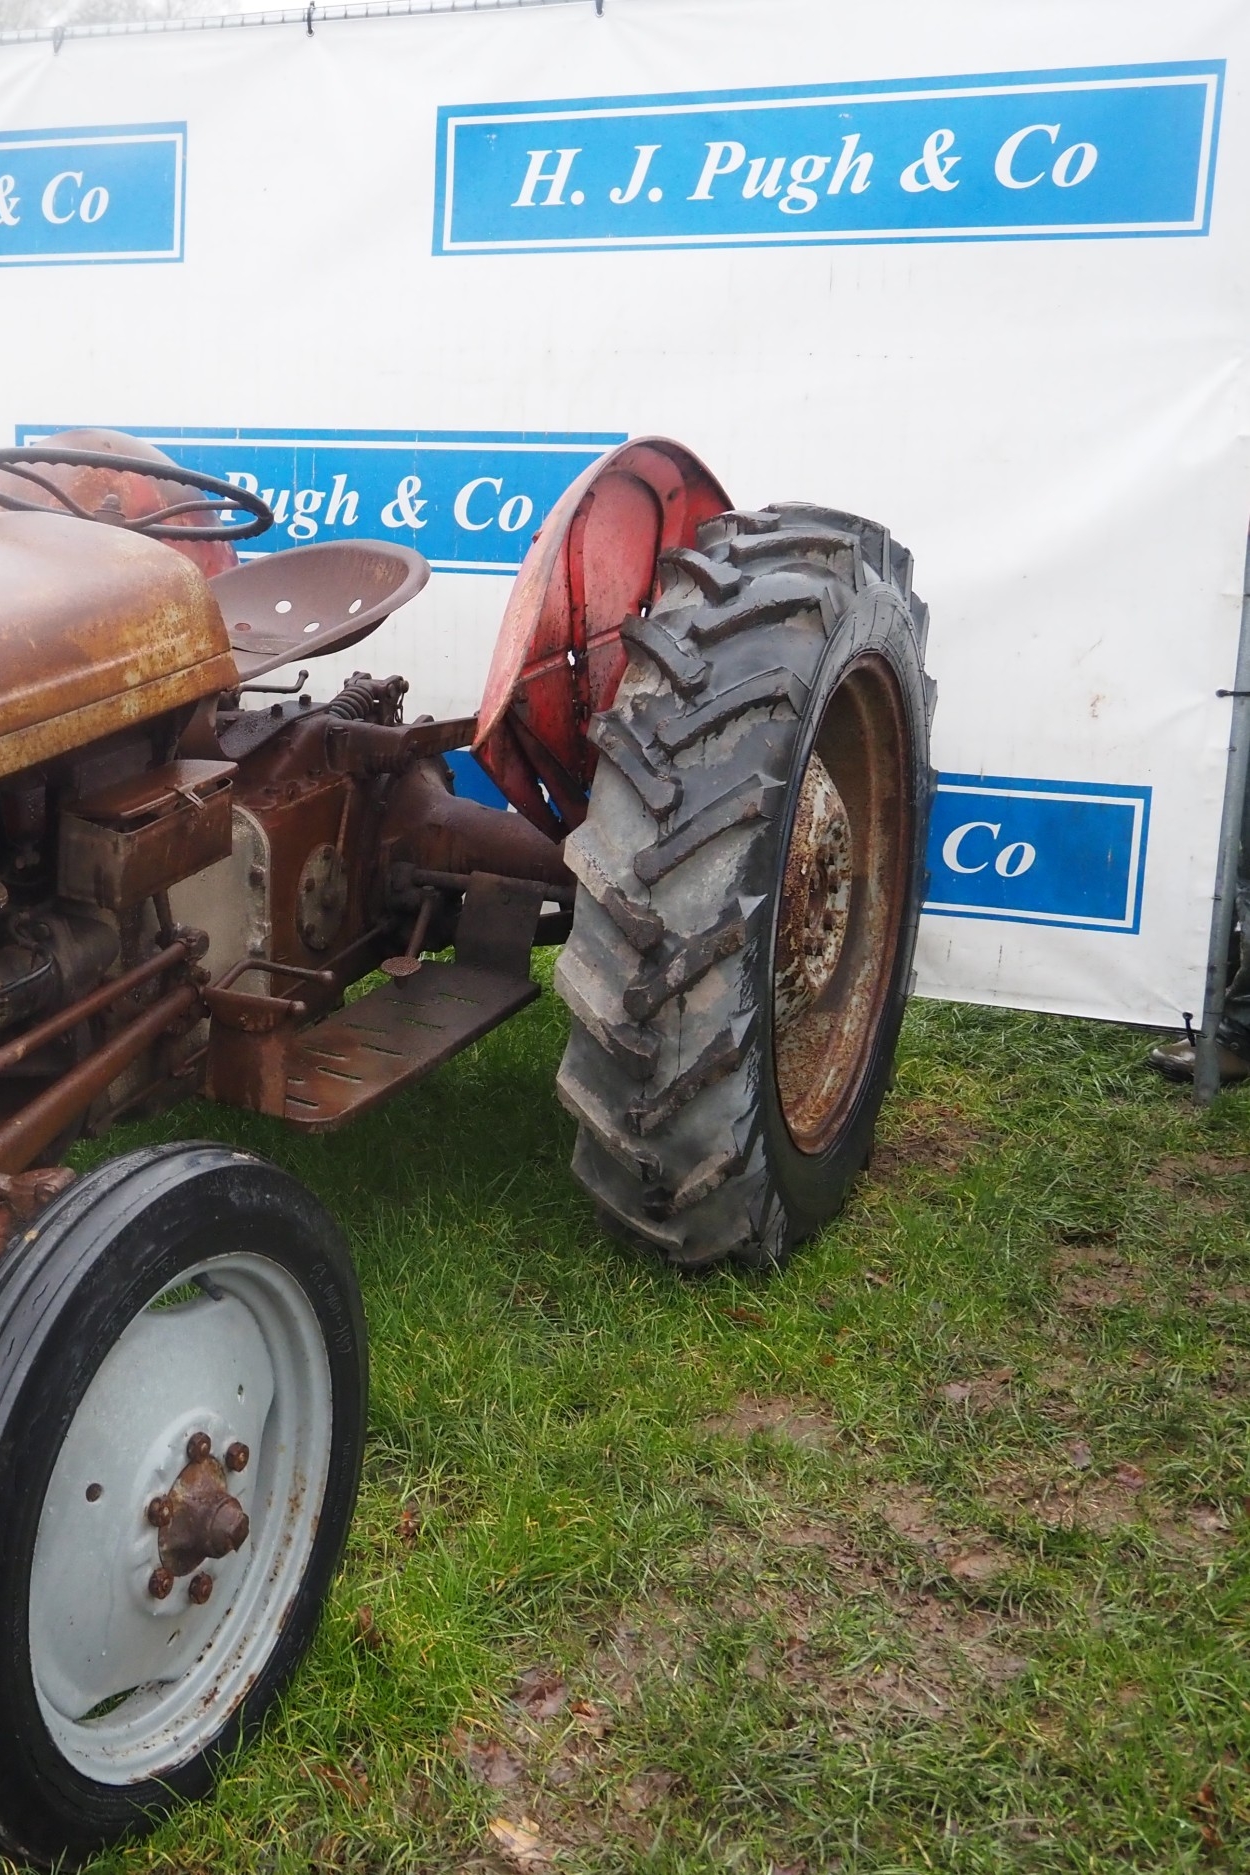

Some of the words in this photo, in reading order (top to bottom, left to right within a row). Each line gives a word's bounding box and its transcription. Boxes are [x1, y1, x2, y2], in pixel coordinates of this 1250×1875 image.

[41, 170, 110, 225] Co
[511, 148, 585, 207] H.
[609, 144, 663, 205] J.
[686, 133, 873, 214] Pugh
[900, 128, 961, 193] &
[994, 123, 1098, 189] Co
[219, 471, 360, 539] Pugh
[380, 475, 428, 529] &
[453, 477, 533, 532] Co
[942, 821, 1037, 877] Co
